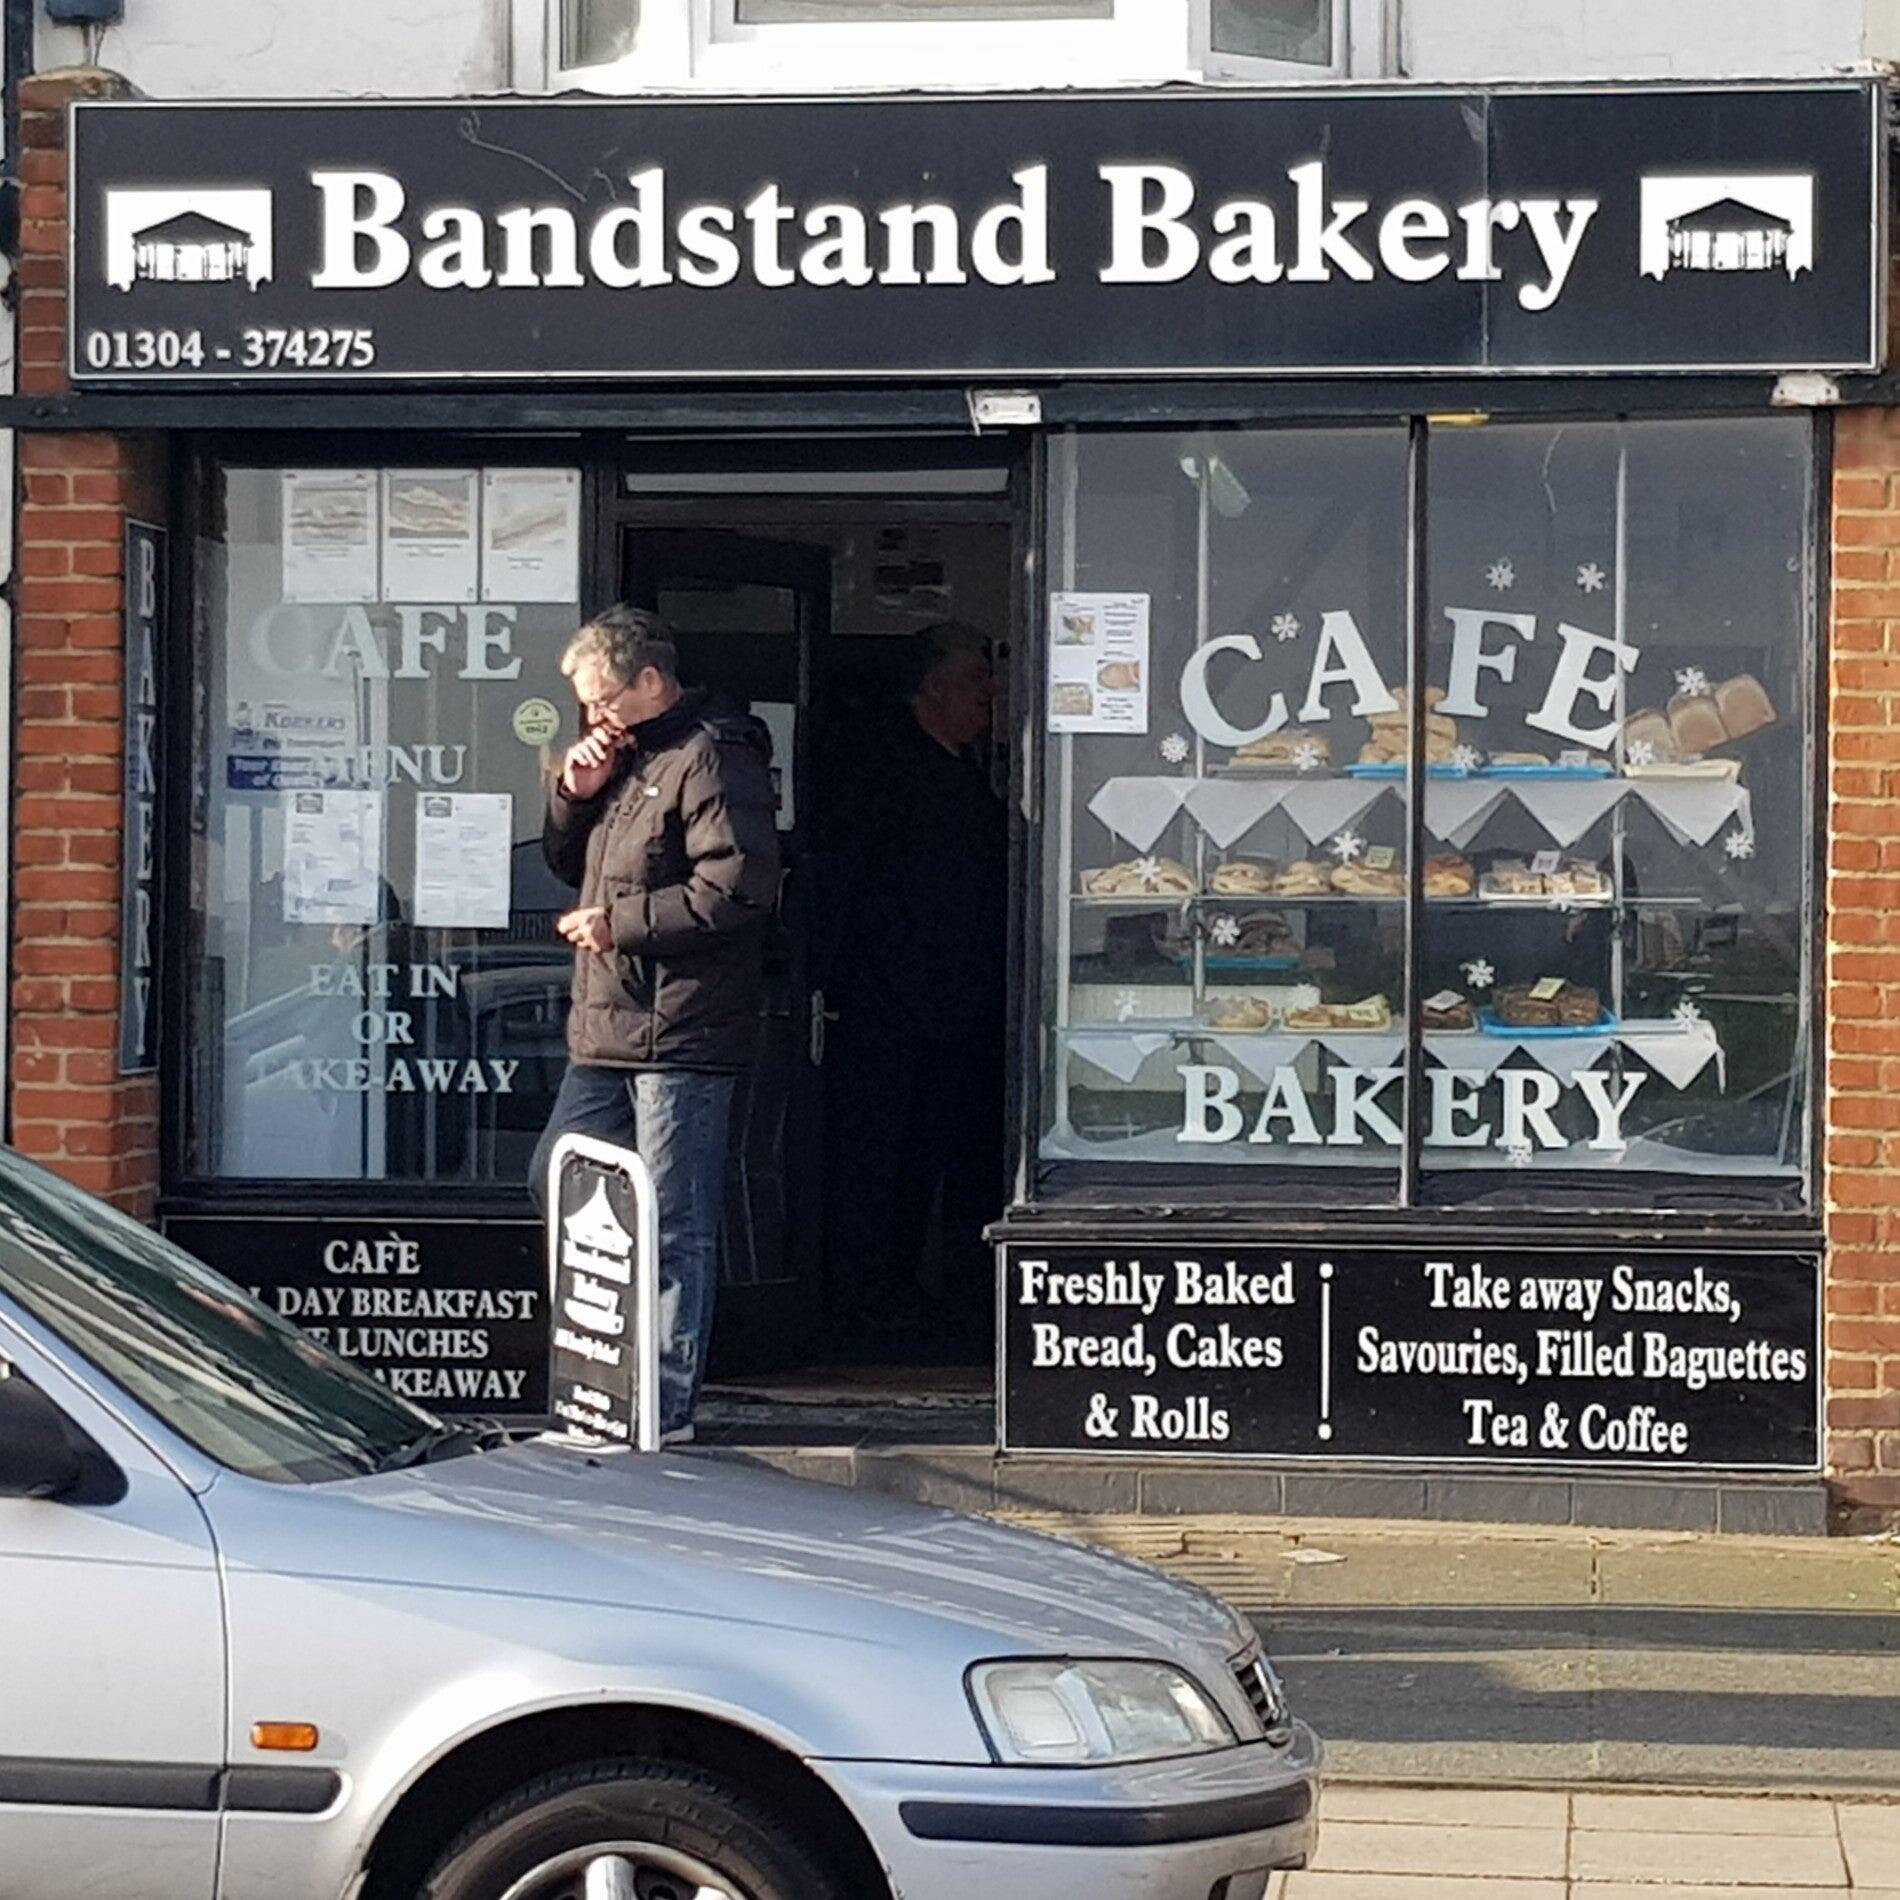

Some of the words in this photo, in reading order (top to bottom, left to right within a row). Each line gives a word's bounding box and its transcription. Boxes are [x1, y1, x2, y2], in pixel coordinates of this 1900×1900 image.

[310, 164, 1056, 288] Bandstand
[1099, 161, 1598, 311] Bakery
[87, 330, 205, 368] 01304
[242, 329, 374, 367] 374275
[252, 605, 522, 680] CAFE
[1180, 606, 1640, 751] CAFE
[138, 538, 157, 1057] BAKERY
[308, 965, 399, 997] EAT
[410, 965, 462, 997] IN
[352, 1011, 414, 1044] OR
[1177, 1065, 1648, 1151] BAKERY
[277, 1286, 345, 1316] DAY
[351, 1288, 538, 1319] BREAKFAST
[1018, 1260, 1166, 1315] Freshly
[1174, 1261, 1296, 1305] Baked
[1424, 1262, 1511, 1309] Take
[1519, 1276, 1603, 1322] away
[1612, 1265, 1742, 1323] Snacks,
[338, 1328, 489, 1358] LUNCHES
[1032, 1323, 1157, 1376] Bread,
[1166, 1322, 1284, 1368] Cakes
[1357, 1325, 1529, 1385] Savouries,
[1536, 1329, 1632, 1378] Filled
[1643, 1331, 1807, 1390] Baguettes
[374, 1367, 527, 1399] KEAWAY
[1084, 1393, 1118, 1438] &
[1130, 1394, 1230, 1441] Rolls
[1462, 1399, 1528, 1447] Tea
[1539, 1401, 1570, 1449] &
[1579, 1403, 1689, 1454] Coffee
